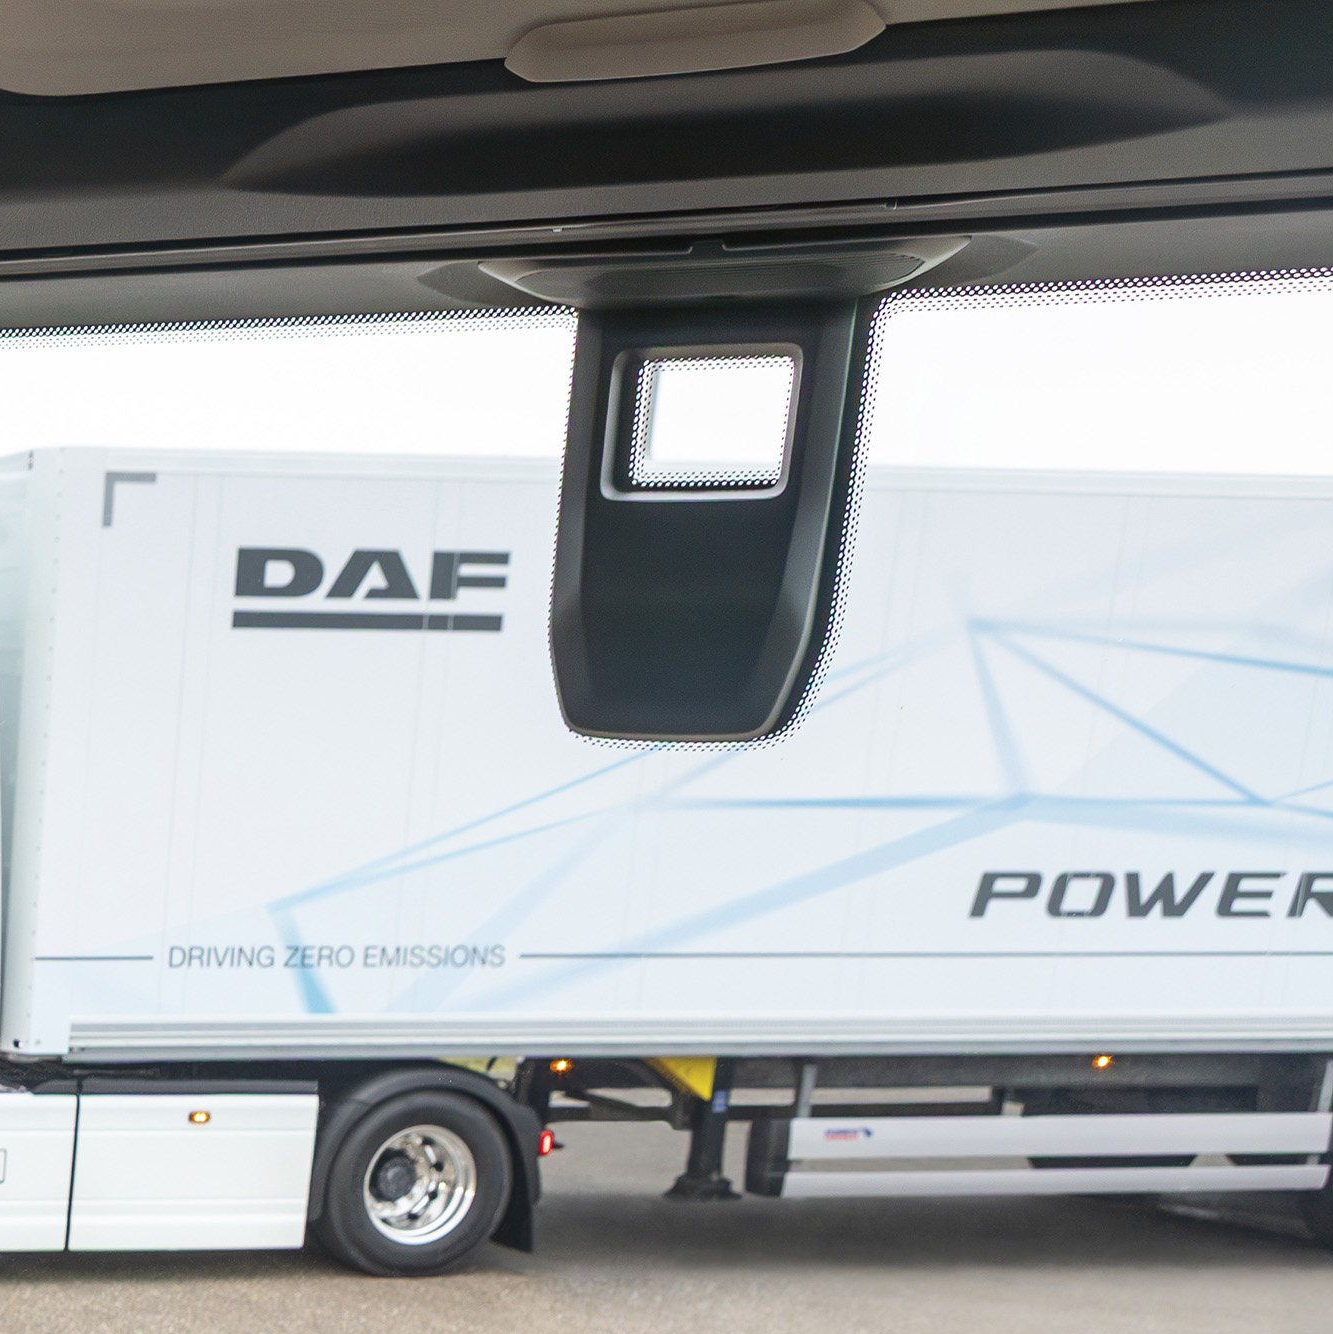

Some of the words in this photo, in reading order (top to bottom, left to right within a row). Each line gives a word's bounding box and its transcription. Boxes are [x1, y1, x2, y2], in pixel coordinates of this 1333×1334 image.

[234, 545, 512, 601] DAF
[967, 872, 1333, 918] POWER
[168, 945, 275, 968] DRIVING
[283, 945, 355, 968] ZERO
[362, 944, 506, 968] EMISSIONS
